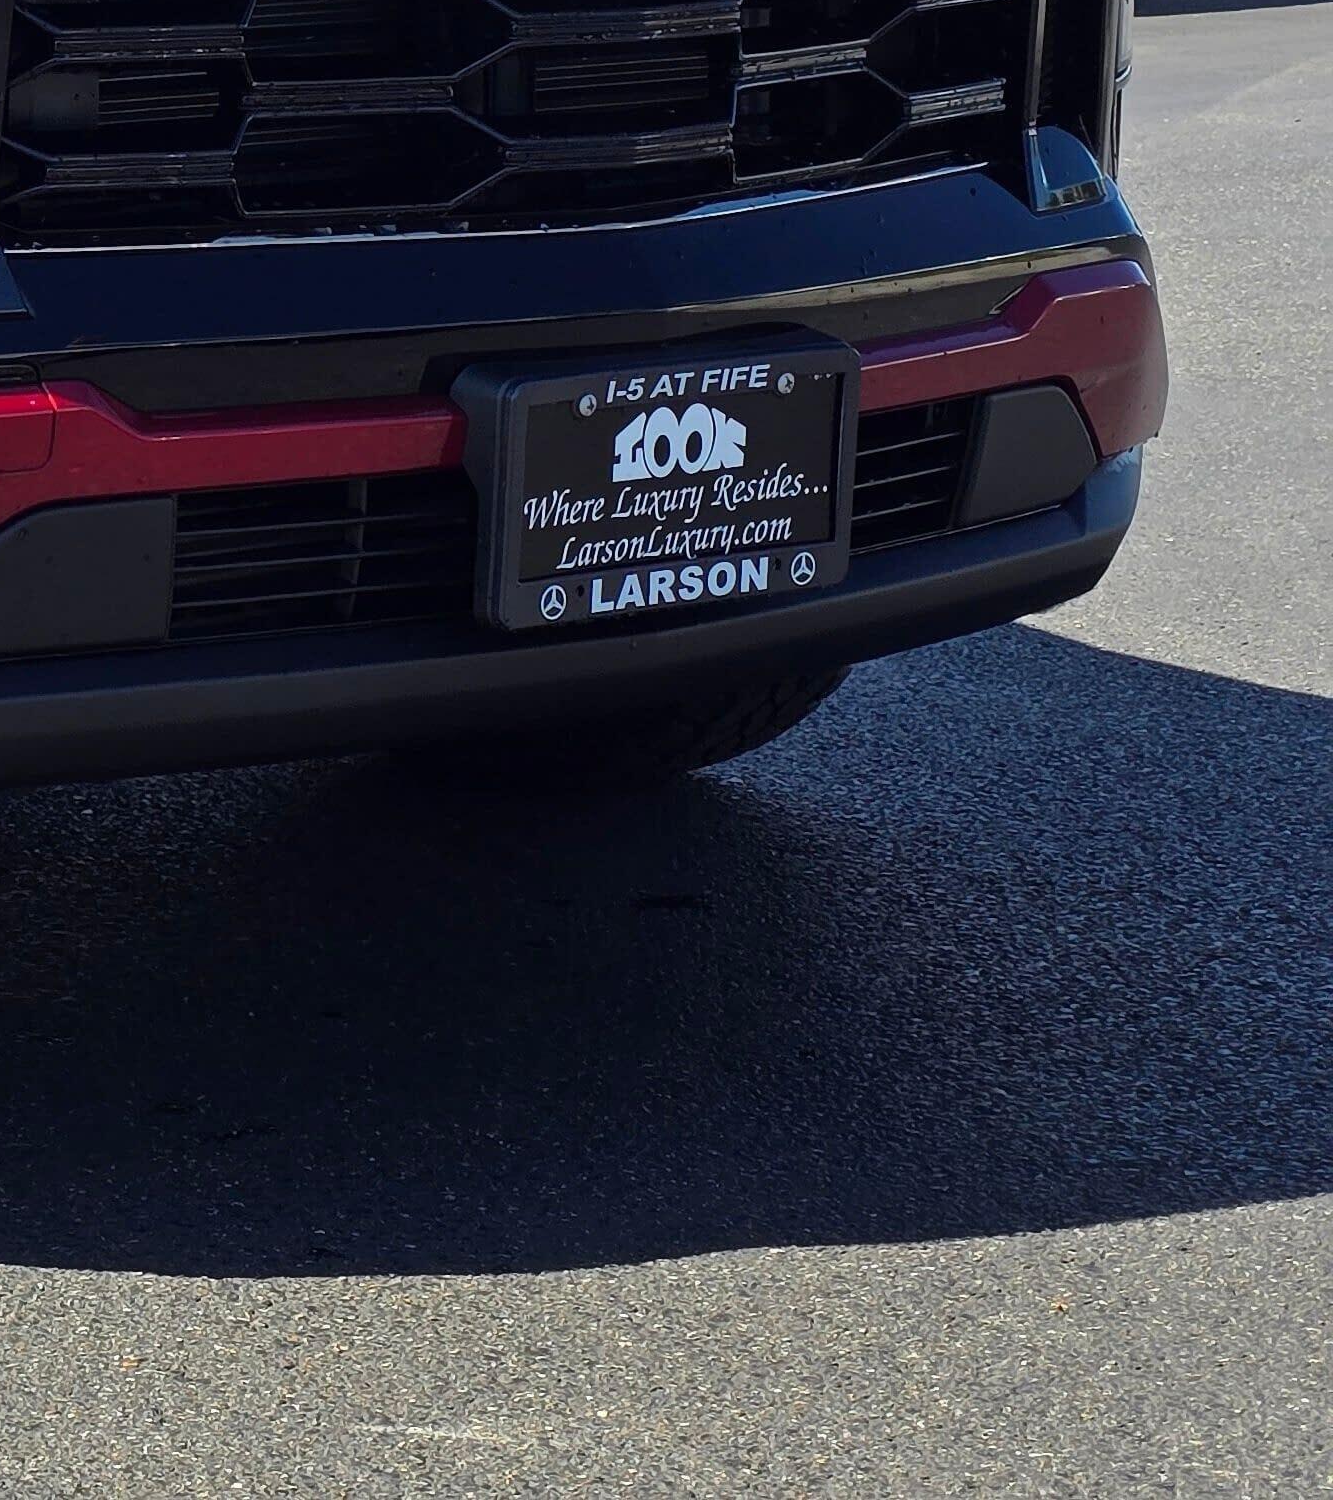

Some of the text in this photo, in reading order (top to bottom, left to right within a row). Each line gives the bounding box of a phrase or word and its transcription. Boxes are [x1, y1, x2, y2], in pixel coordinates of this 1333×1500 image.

[606, 363, 771, 404] I-5 AT FIFE
[523, 489, 604, 531] Where
[610, 482, 704, 523] Luxury
[555, 515, 793, 571] LarsonLuxury.com
[590, 556, 769, 615] LARSON
